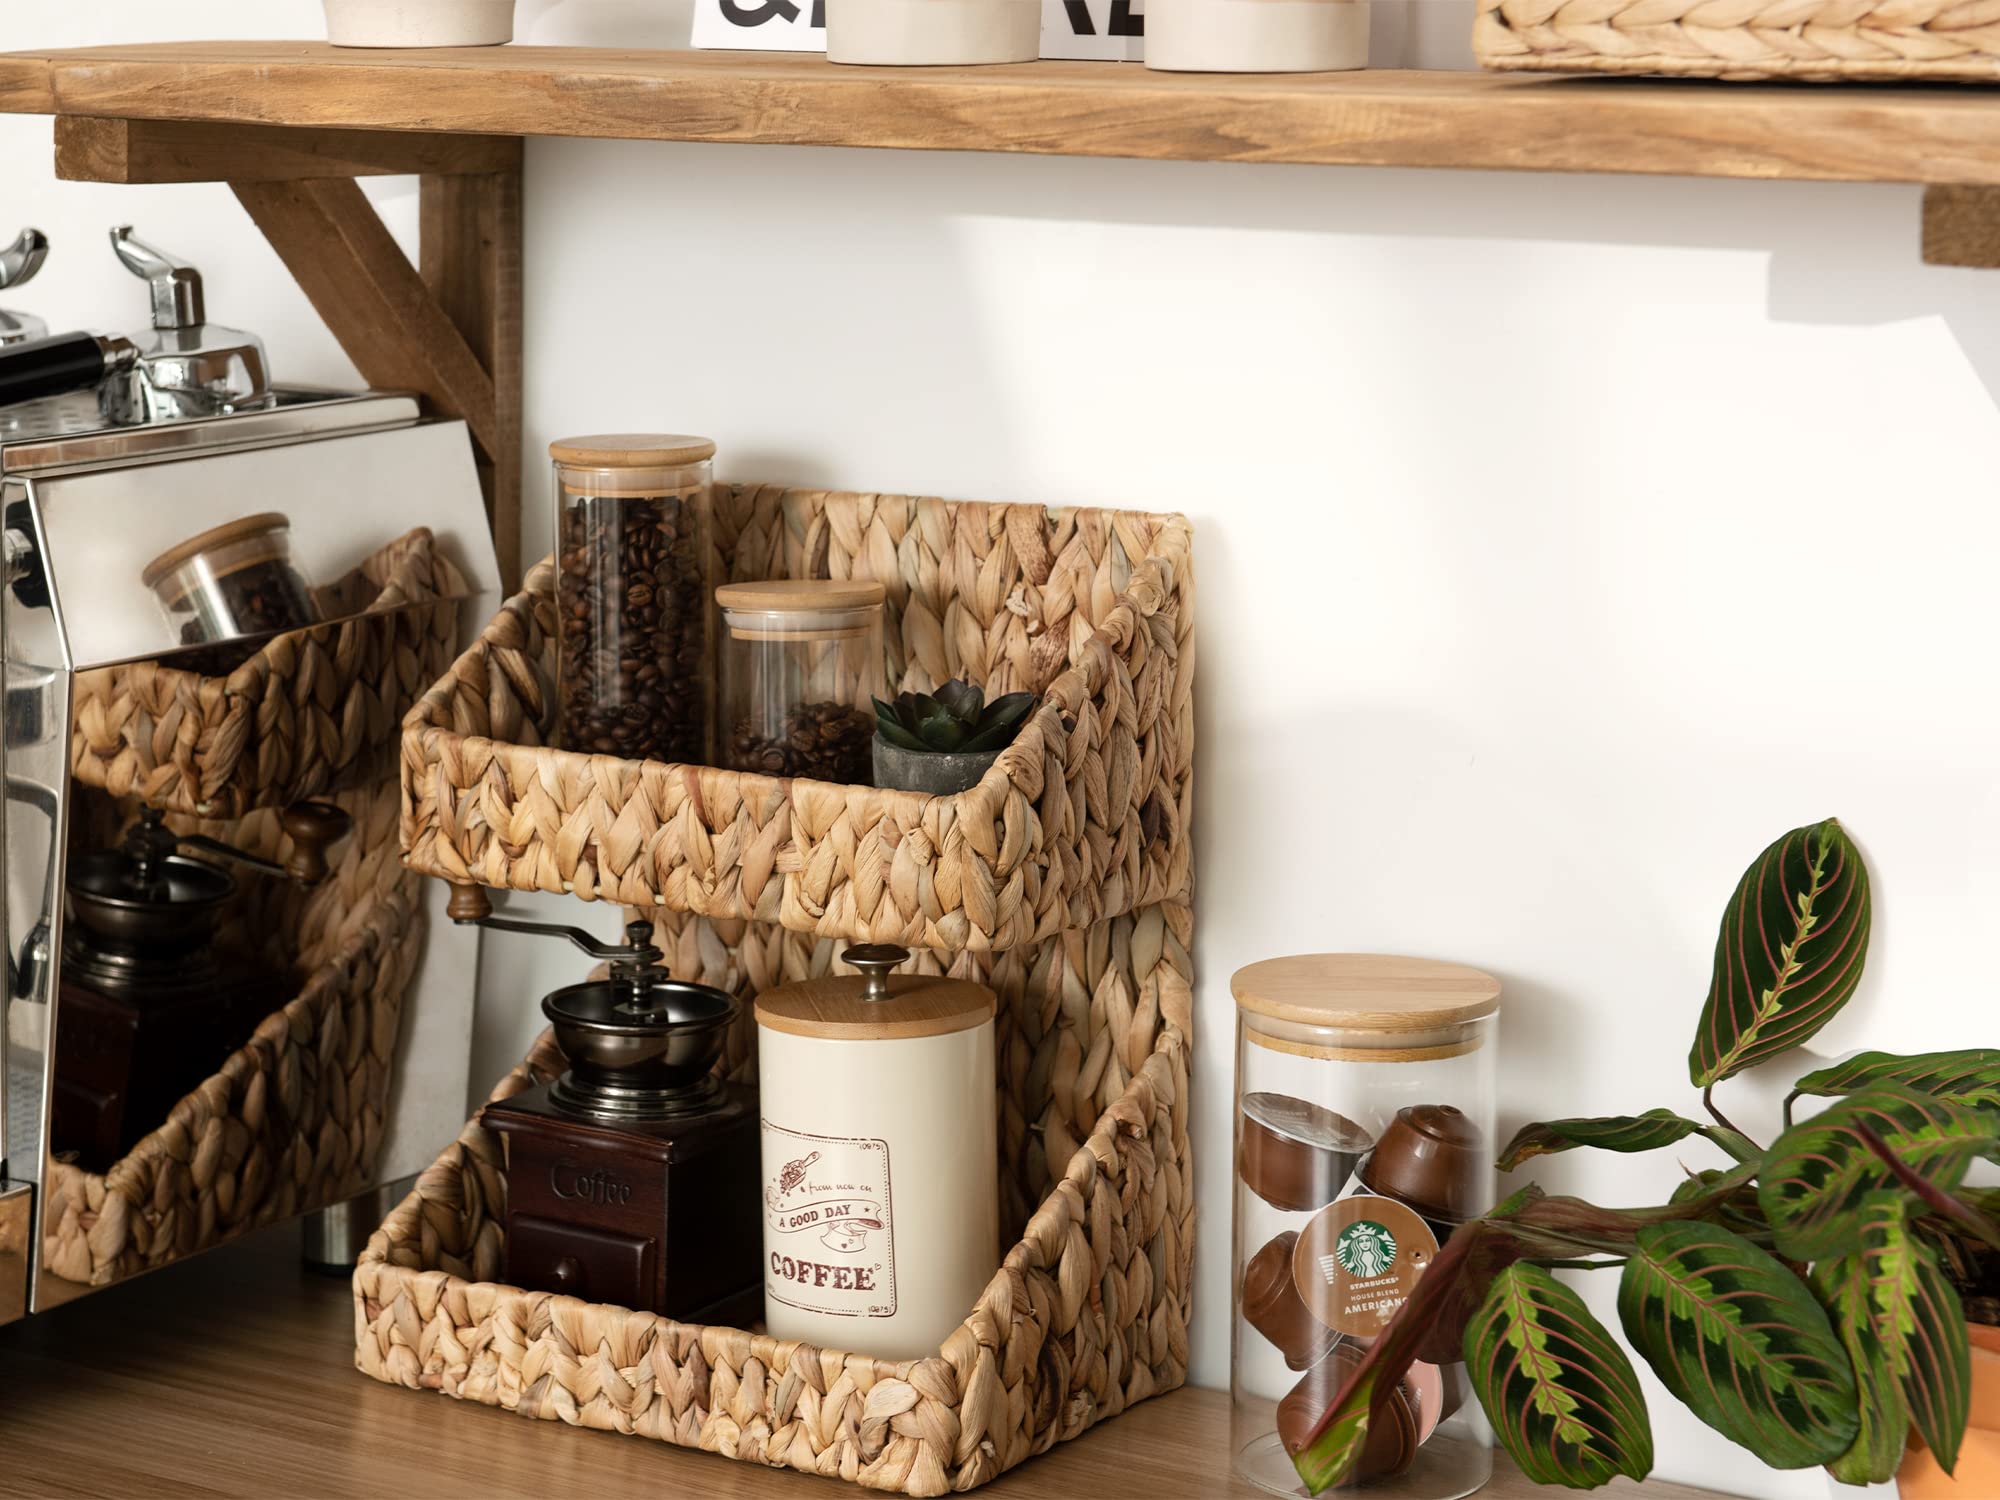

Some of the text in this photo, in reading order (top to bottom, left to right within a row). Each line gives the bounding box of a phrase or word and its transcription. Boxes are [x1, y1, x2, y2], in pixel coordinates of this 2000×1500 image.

[551, 1163, 632, 1207] Coffee
[779, 1204, 851, 1228] A GOOD DAY
[770, 1251, 876, 1291] COFFEE
[1350, 1288, 1400, 1302] HOUSE BLEND
